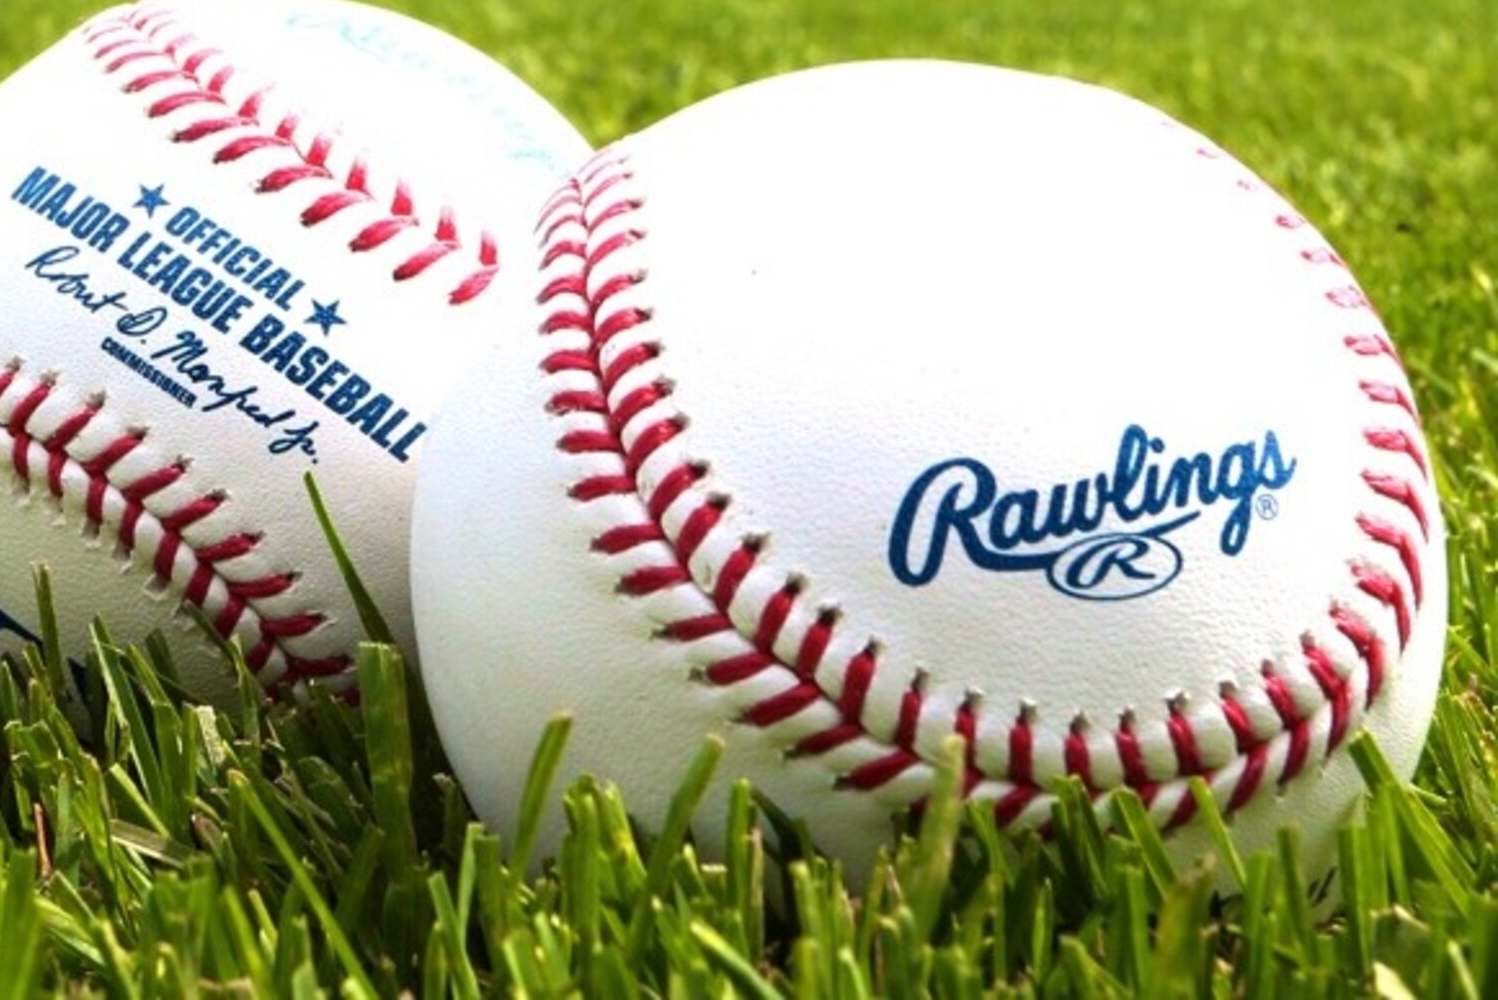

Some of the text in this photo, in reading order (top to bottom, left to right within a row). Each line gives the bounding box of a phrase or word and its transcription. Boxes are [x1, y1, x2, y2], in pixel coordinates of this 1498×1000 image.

[11, 166, 427, 463] MAJOR LEAGUE BASEBALL
[165, 206, 305, 311] OFFICIAL
[101, 336, 198, 408] COMMISSIONER
[888, 423, 1297, 588] Rawlings
